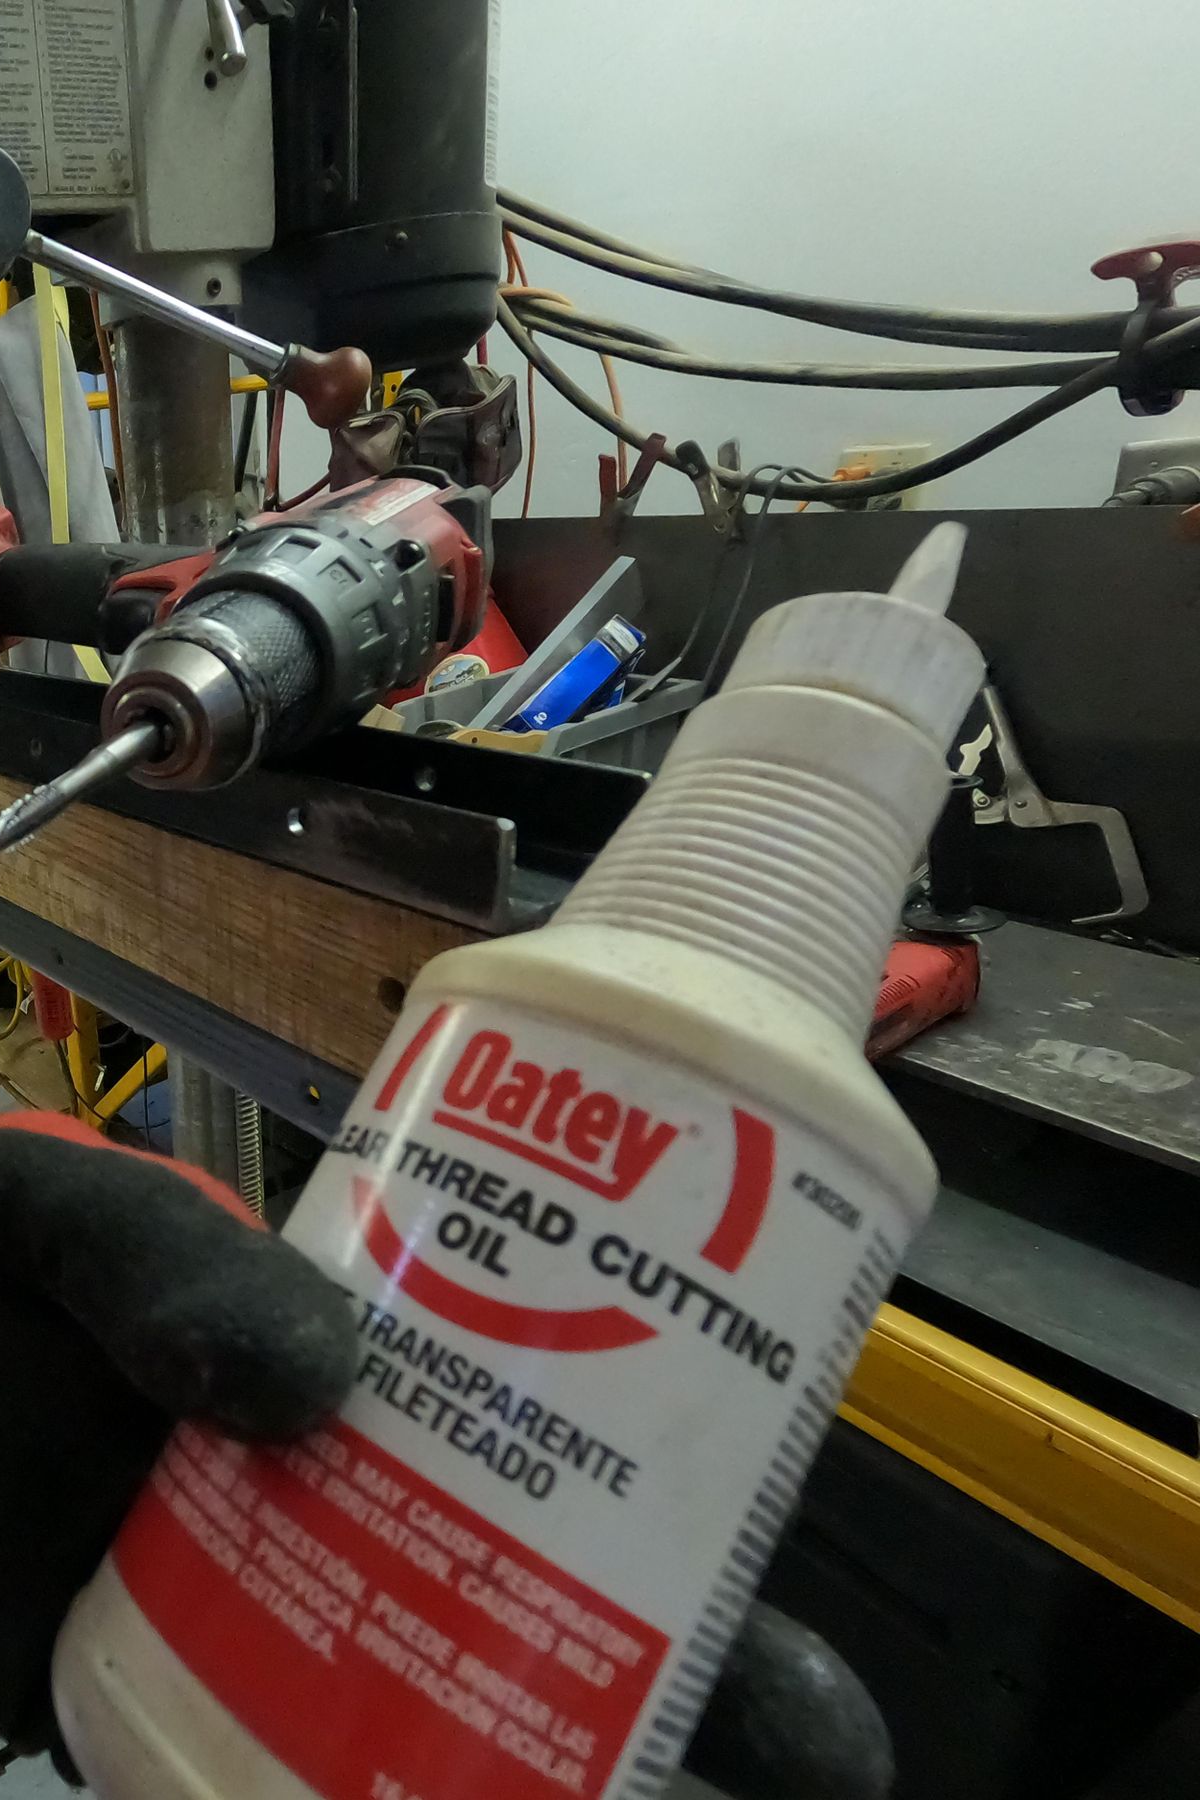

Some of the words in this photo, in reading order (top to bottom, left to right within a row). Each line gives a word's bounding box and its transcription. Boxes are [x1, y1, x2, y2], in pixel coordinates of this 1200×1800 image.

[442, 1029, 679, 1203] Oatey
[396, 1140, 577, 1246] THREAD
[590, 1234, 796, 1385] CUTTING
[437, 1212, 510, 1279] OIL
[356, 1302, 638, 1498] TRANSPARENTE
[357, 1352, 557, 1501] FILETEADO
